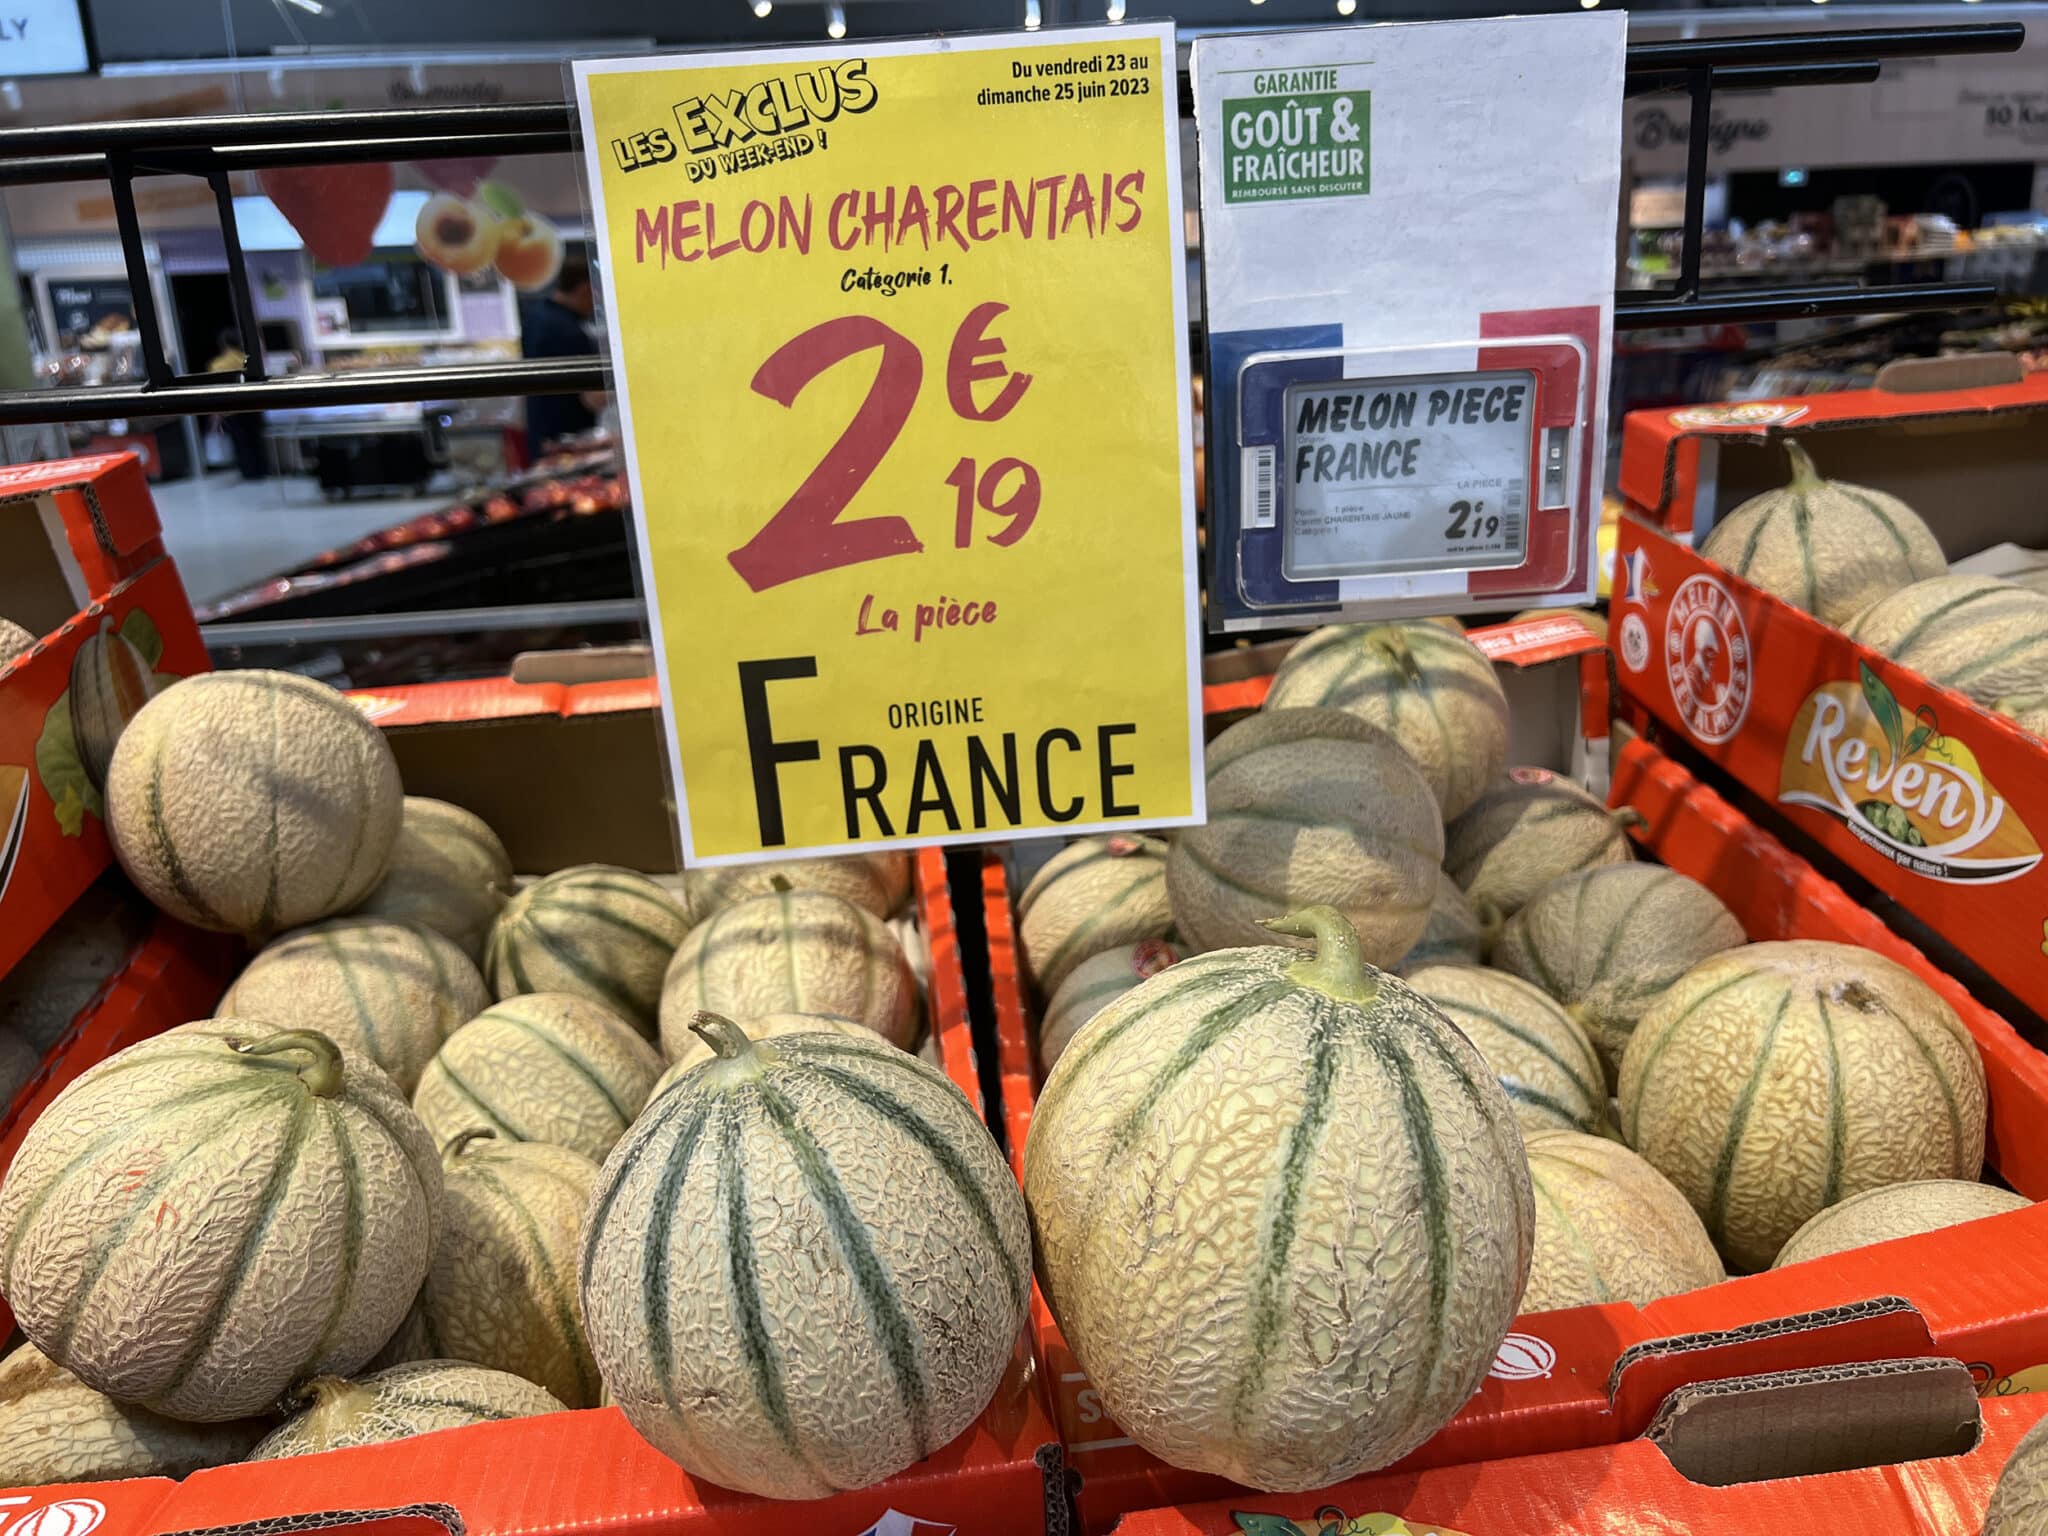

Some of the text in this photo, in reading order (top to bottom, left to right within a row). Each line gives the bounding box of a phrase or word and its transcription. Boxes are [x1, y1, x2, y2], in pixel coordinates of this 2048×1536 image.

[1012, 54, 1149, 78] Du vendredi 23 au
[1254, 70, 1337, 94] GARANTIE
[977, 77, 1150, 106] dimanche 25 juin 2023
[612, 58, 878, 173] LES EXCLUS
[1231, 96, 1361, 150] GOÛT &
[685, 128, 828, 183] DU WEEK-END !
[1232, 146, 1364, 183] FRAÎCHEUR
[1291, 183, 1316, 194] SANS
[1319, 181, 1363, 193] DISCUTER
[635, 169, 1146, 270] MELON CHARENTAIS
[939, 263, 953, 285] 1.
[1296, 385, 1526, 434] MELON PIECE
[727, 301, 1042, 593] 2 € 19
[1295, 438, 1421, 484] FRANCE
[1444, 500, 1471, 539] 2
[1472, 515, 1500, 539] 19
[855, 593, 998, 643] La pièce
[1674, 580, 1736, 628] MELON
[888, 697, 984, 729] ORIGINE
[738, 655, 1141, 847] FRANCE
